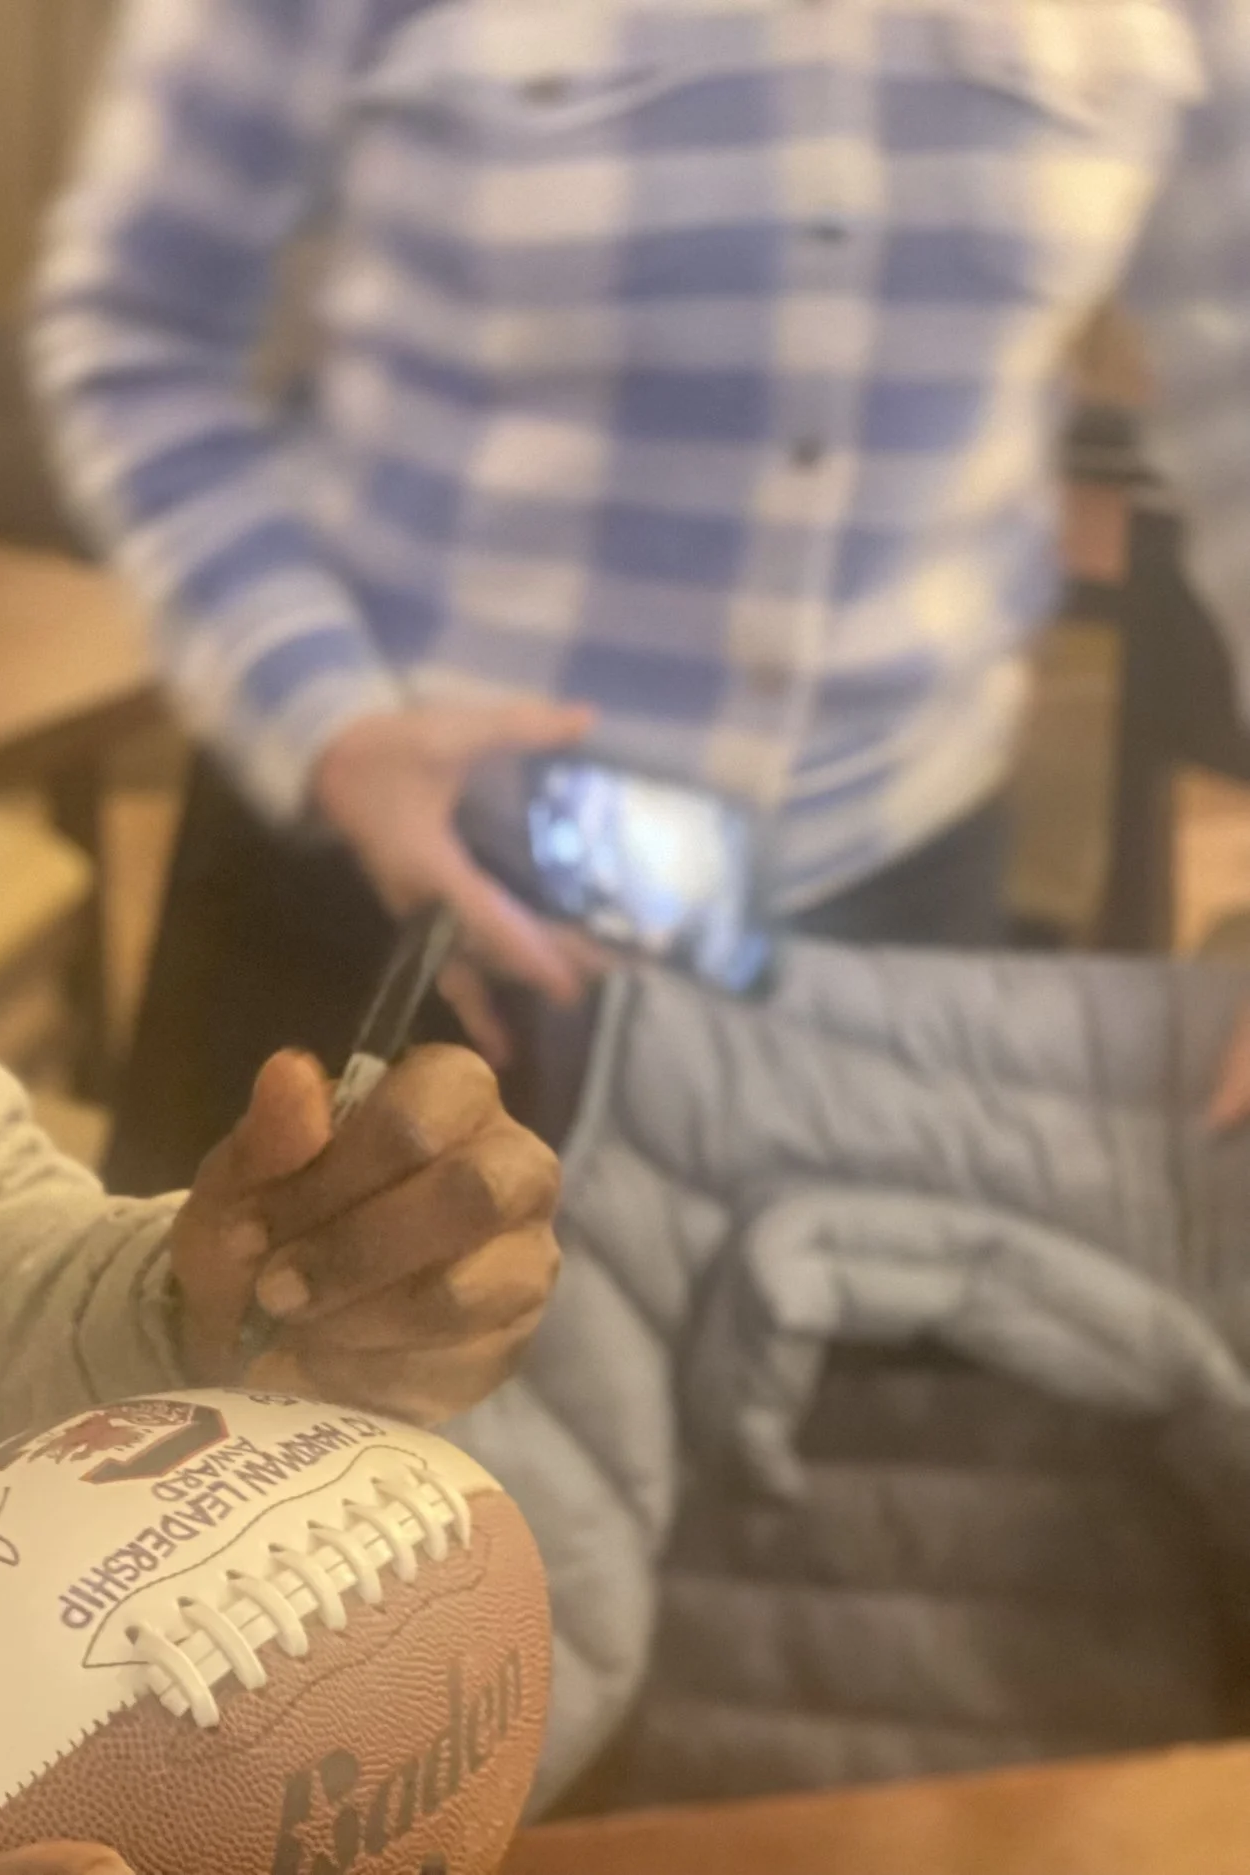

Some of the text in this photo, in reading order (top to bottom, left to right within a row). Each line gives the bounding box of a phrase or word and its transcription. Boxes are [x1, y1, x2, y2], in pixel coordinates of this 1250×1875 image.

[150, 1435, 257, 1500] AWARD
[57, 1480, 250, 1630] LEADERSHIP
[270, 1648, 522, 1875] Baden
